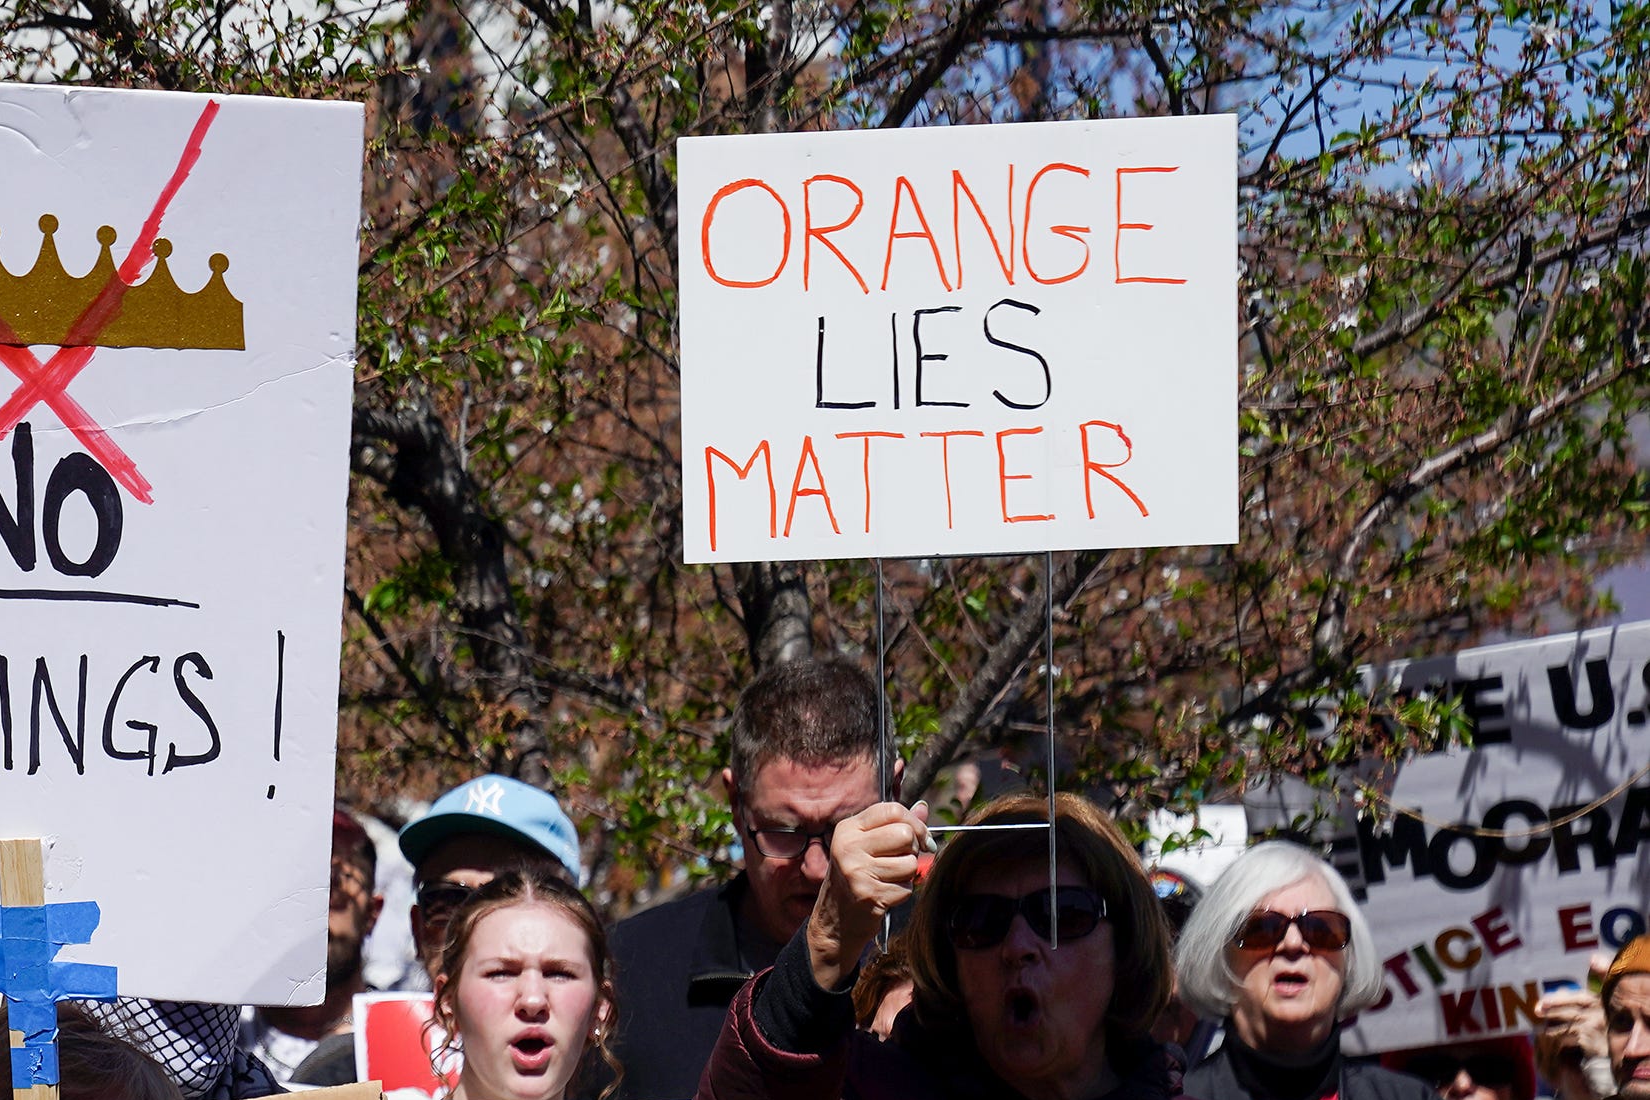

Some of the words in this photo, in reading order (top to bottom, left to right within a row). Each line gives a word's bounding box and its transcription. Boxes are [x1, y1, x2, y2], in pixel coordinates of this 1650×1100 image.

[701, 162, 1188, 294] ORANGE
[815, 298, 1052, 411] LIES
[705, 420, 1150, 553] MATTER
[1547, 658, 1650, 730] U.
[464, 780, 506, 816] NY
[1440, 977, 1582, 1037] KIN
